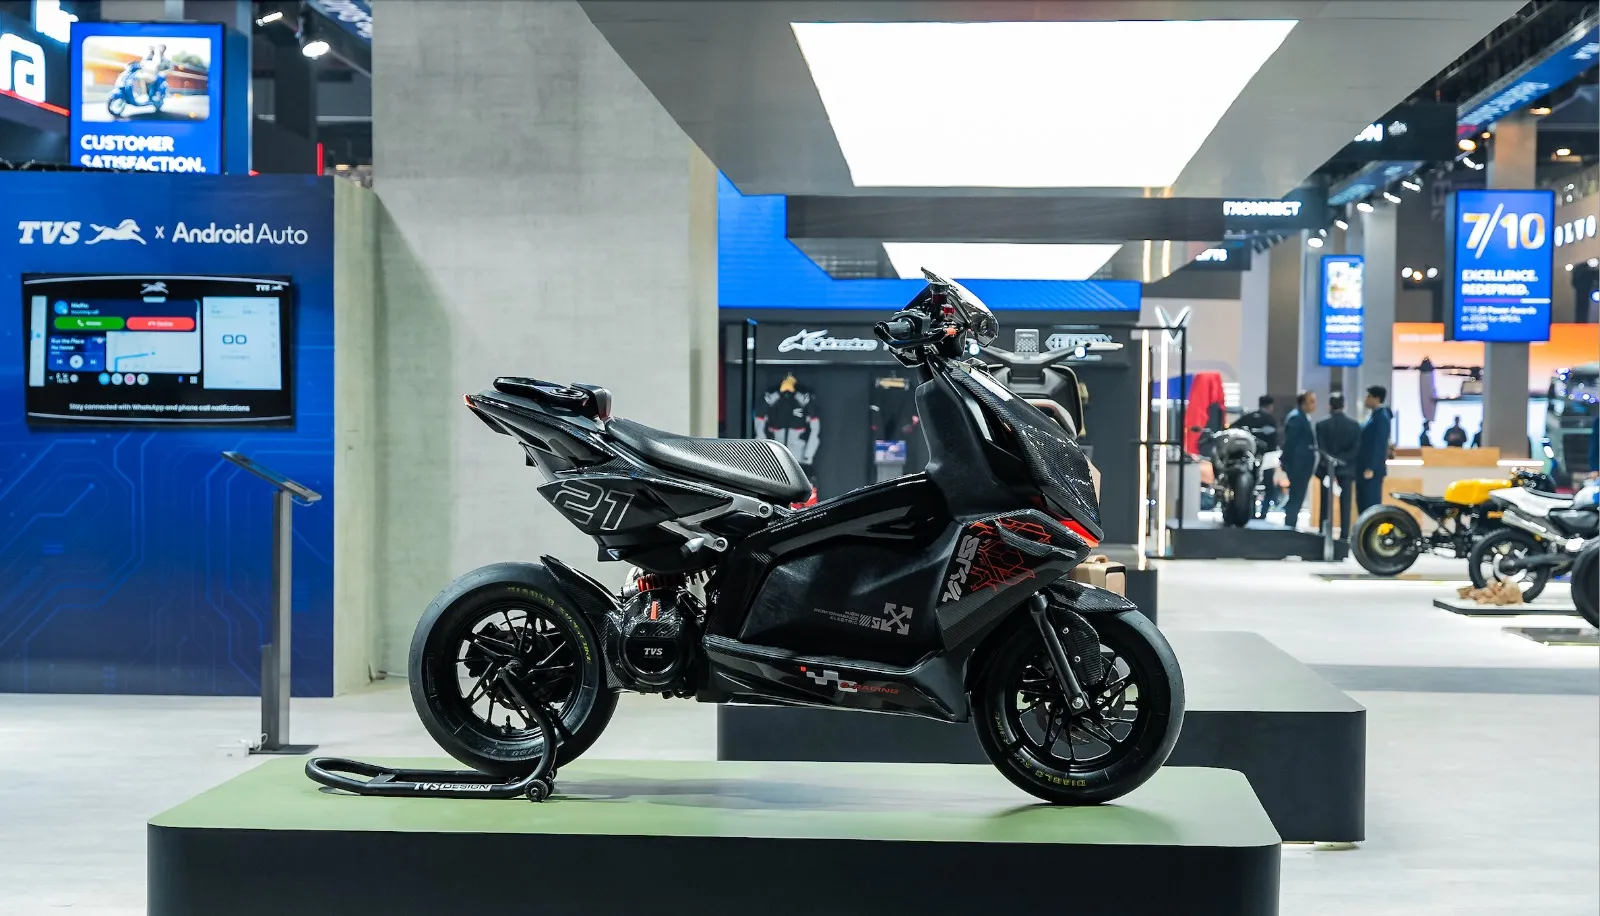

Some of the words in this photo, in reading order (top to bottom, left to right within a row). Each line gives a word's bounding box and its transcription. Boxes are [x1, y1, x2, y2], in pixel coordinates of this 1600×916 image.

[80, 134, 174, 152] CUSTOMER
[80, 154, 206, 173] SATISFACTION.
[18, 221, 81, 244] TVS
[172, 222, 253, 244] Android
[256, 223, 308, 245] Auto
[1463, 203, 1545, 259] 7/10
[1462, 269, 1539, 282] EXCELLENCE.
[1461, 283, 1530, 295] REDEFINED.
[69, 403, 83, 411] Stay
[132, 404, 164, 412] WhatsApp
[552, 479, 635, 531] 21
[830, 615, 858, 625] ELECTRIC
[643, 647, 663, 655] TVS
[1035, 769, 1086, 787] DIABLO
[413, 782, 440, 791] TVS
[440, 783, 493, 792] DESIGN
